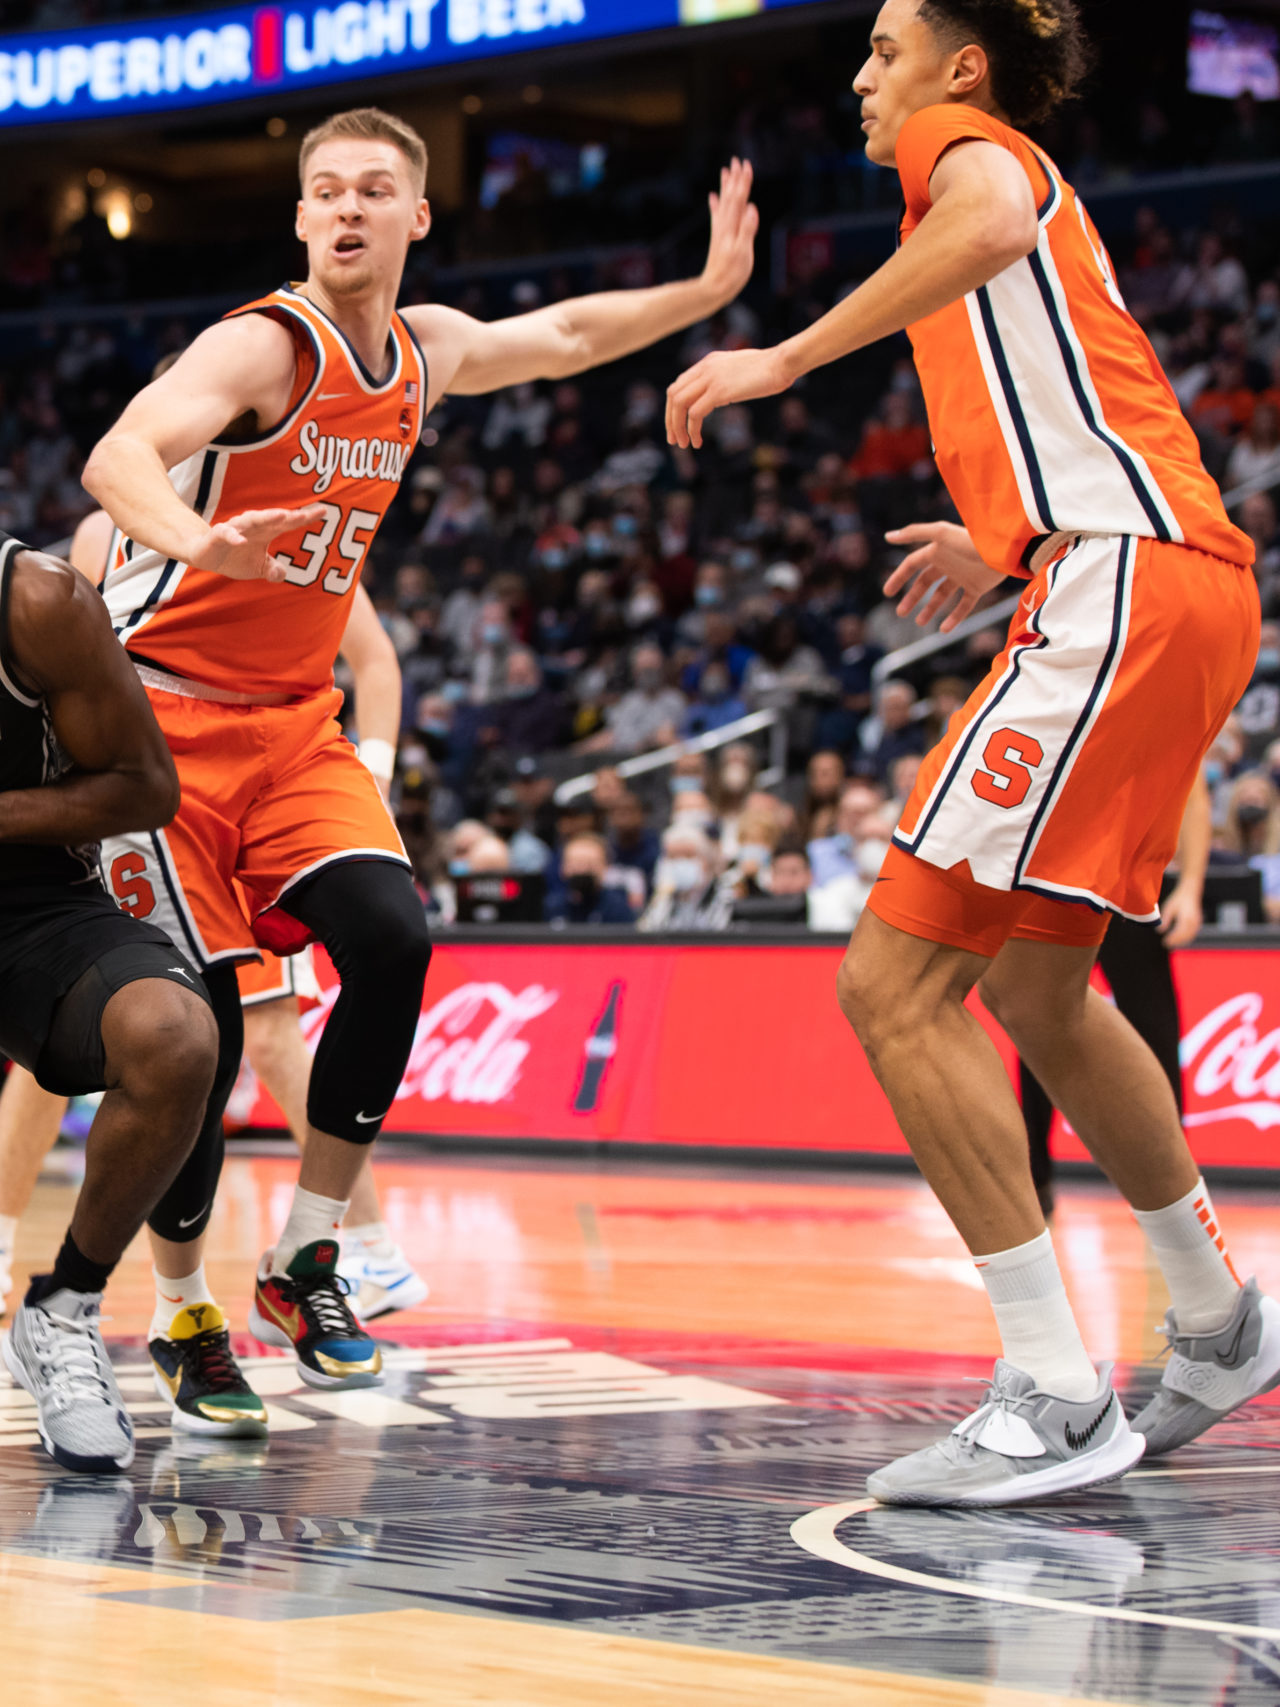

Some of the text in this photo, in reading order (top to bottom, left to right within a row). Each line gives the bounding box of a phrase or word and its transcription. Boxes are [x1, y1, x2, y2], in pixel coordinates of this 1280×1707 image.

[285, 0, 438, 72] LIGHT
[275, 500, 381, 597] 35
[970, 727, 1044, 809] S
[110, 851, 156, 919] S
